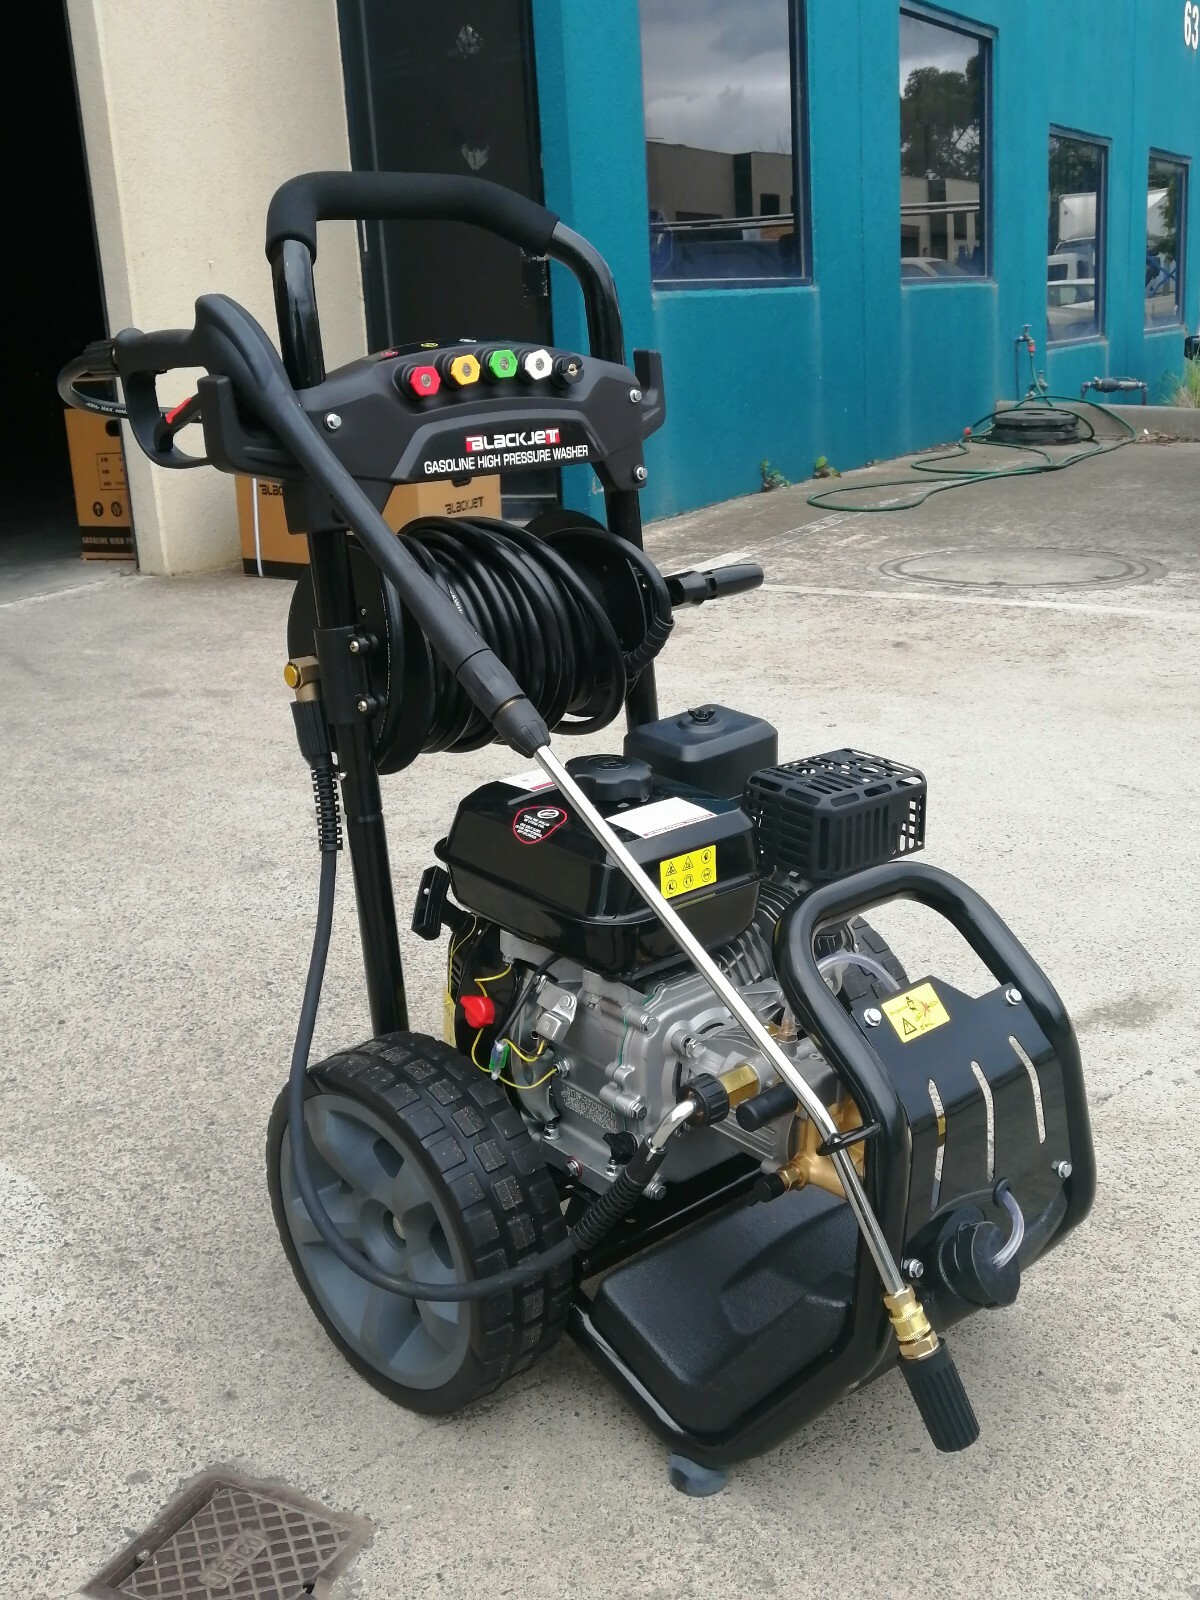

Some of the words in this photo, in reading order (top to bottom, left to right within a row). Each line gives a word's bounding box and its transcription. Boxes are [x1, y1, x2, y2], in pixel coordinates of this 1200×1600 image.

[1184, 1, 1199, 50] 63
[466, 429, 560, 451] BLACKJET
[424, 456, 475, 474] GASOLINE
[477, 453, 501, 469] HIGH
[503, 447, 551, 466] PRESSURE
[552, 444, 588, 460] WASHER
[445, 496, 484, 515] BLACKJET
